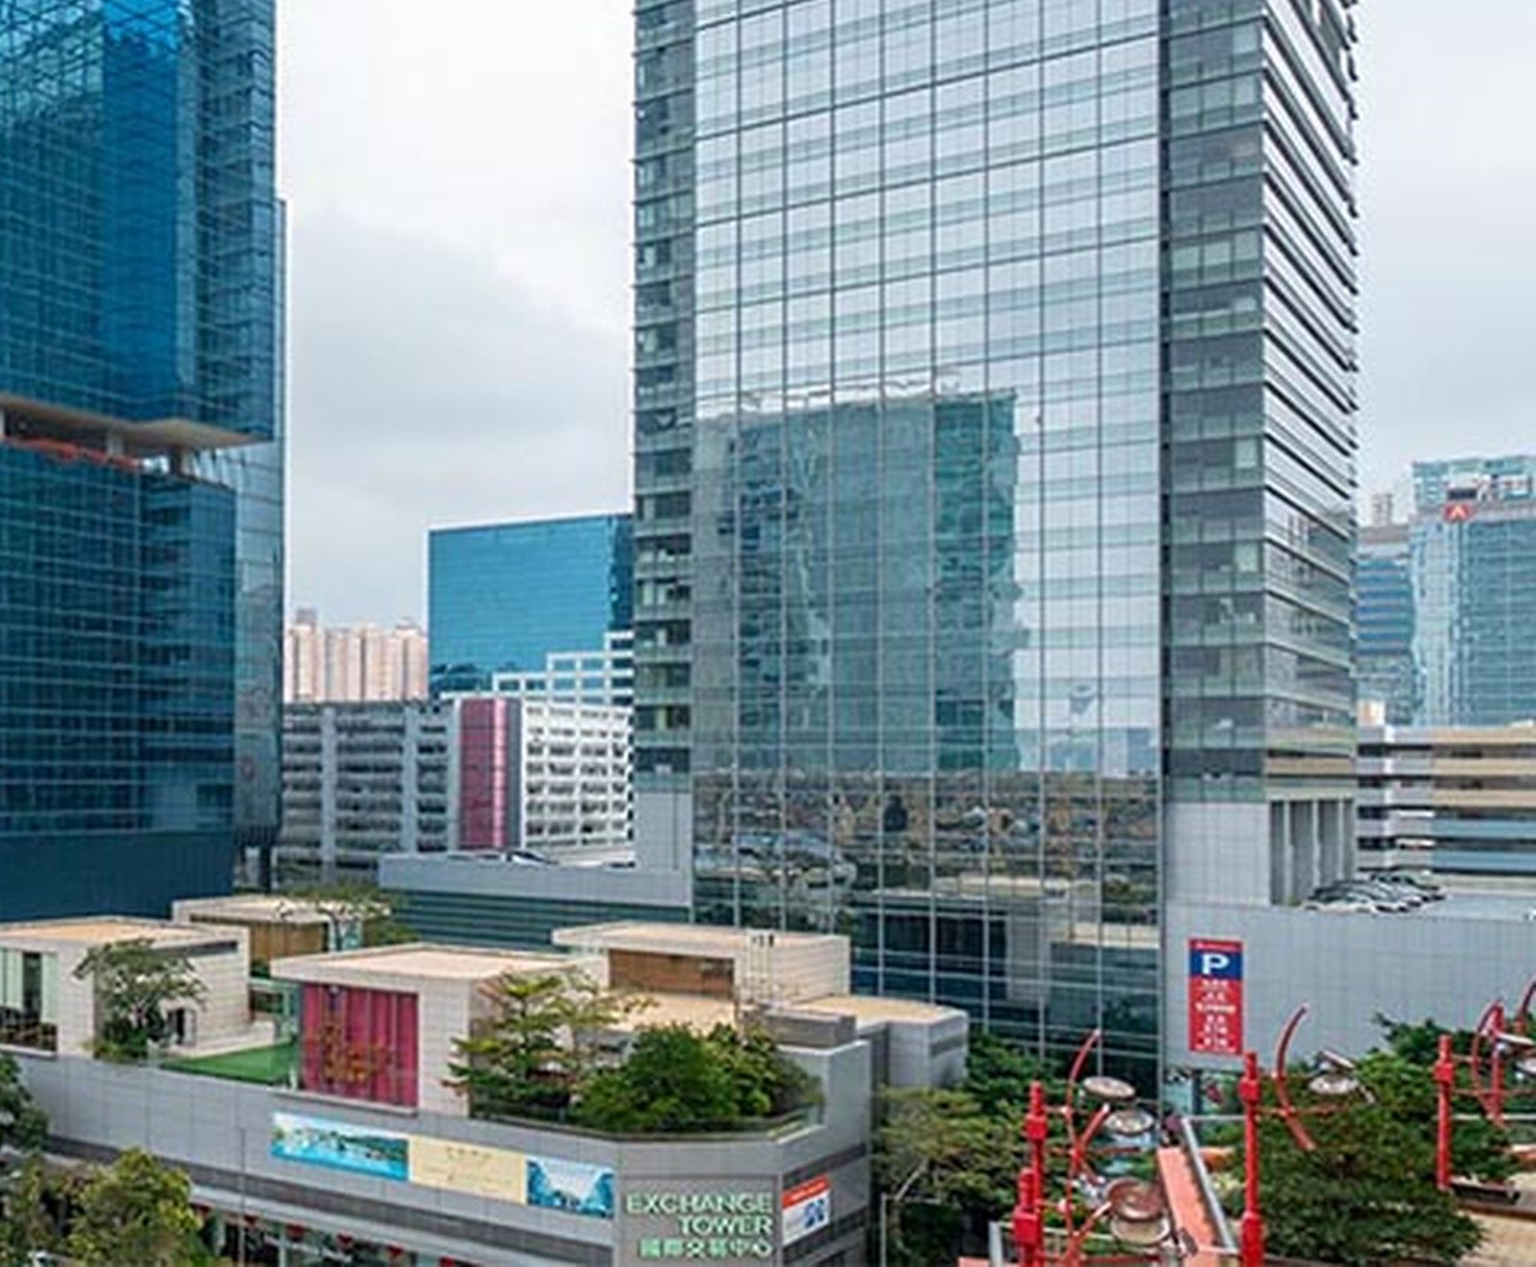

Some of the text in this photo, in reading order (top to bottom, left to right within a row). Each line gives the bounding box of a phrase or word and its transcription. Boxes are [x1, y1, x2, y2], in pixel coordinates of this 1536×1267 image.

[1202, 953, 1230, 975] P
[626, 1191, 774, 1214] EXCHANGE
[679, 1215, 774, 1236] TOWER
